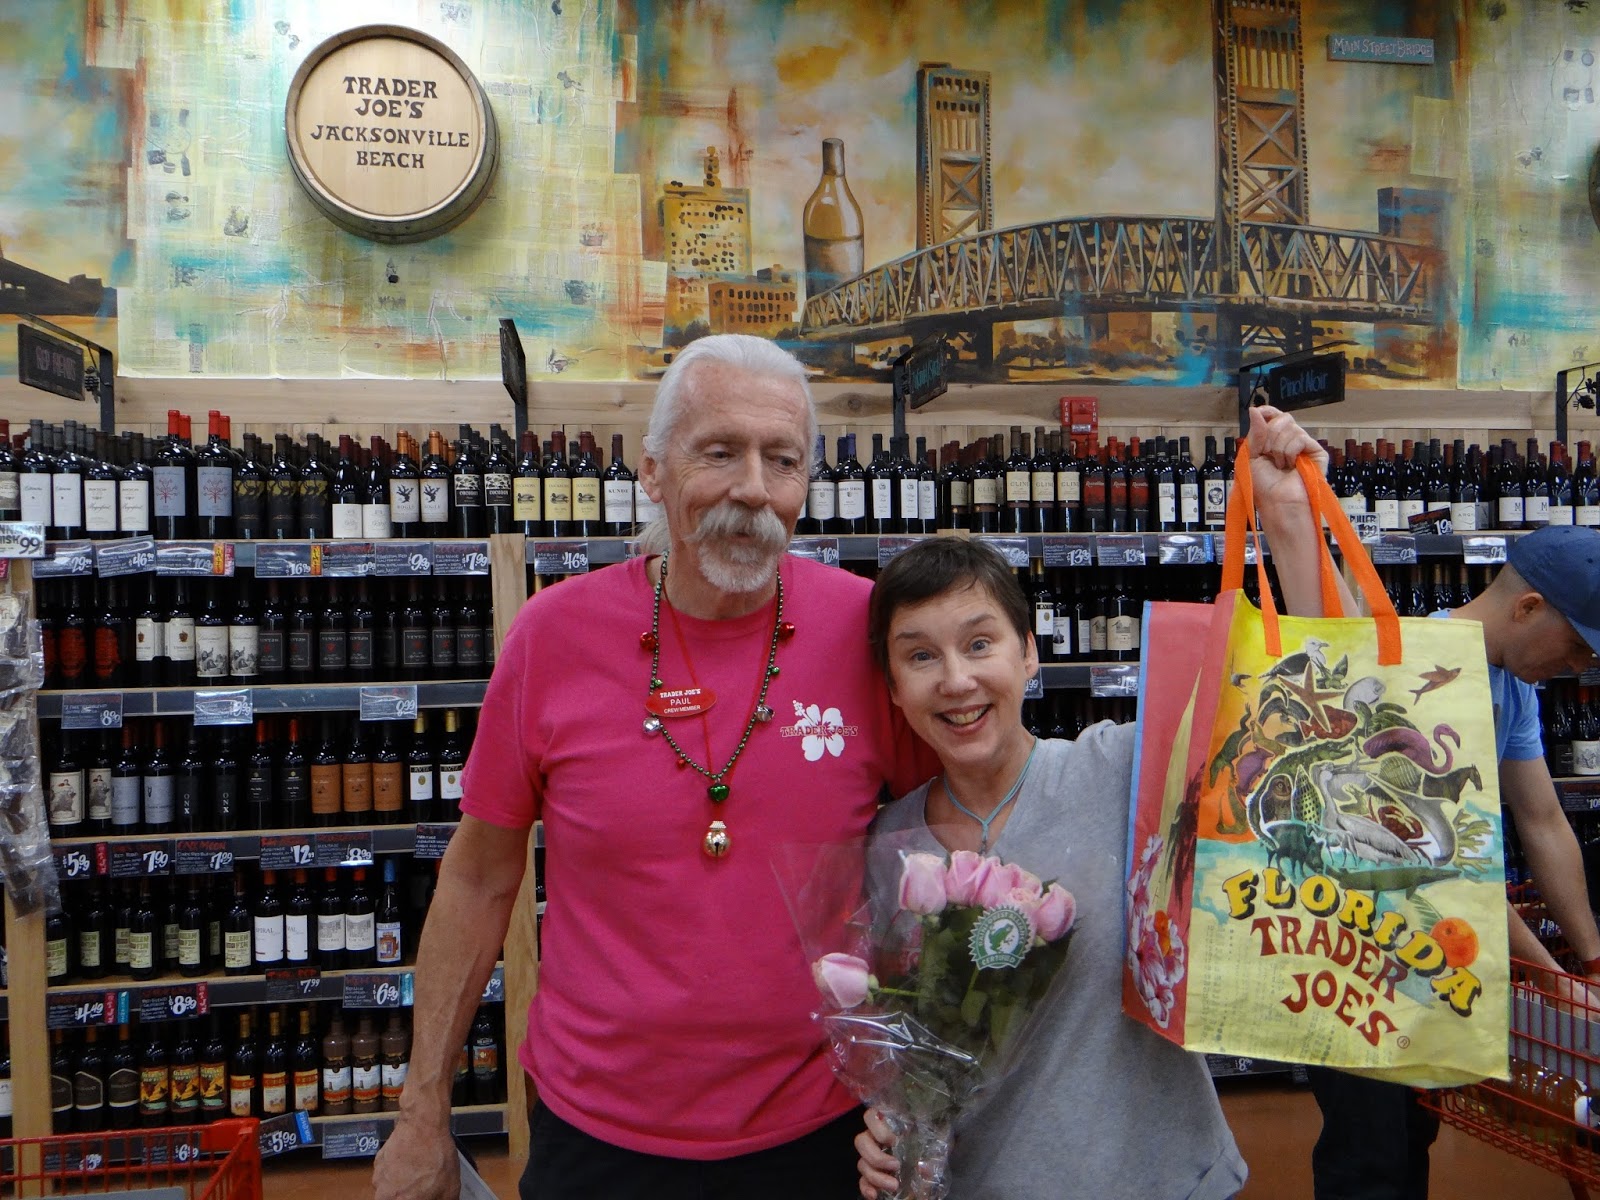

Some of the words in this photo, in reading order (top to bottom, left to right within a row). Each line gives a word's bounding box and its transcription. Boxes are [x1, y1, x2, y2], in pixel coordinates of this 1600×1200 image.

[1333, 39, 1360, 55] MAIN
[1361, 40, 1396, 55] STREET
[1397, 41, 1433, 57] BRIDGE
[343, 76, 438, 99] TRADER
[355, 98, 425, 119] JOE'S
[356, 151, 425, 169] BEACH
[1281, 369, 1305, 400] Pinot
[1305, 368, 1328, 393] Noir
[660, 689, 683, 699] TRADER
[684, 688, 702, 697] JOE'S
[670, 698, 692, 706] PAUL
[664, 706, 679, 714] CREW
[679, 704, 701, 712] MEMBER
[779, 725, 826, 738] TRADER
[830, 725, 859, 737] JOE'S
[1222, 867, 1482, 1018] FLORIDA
[1250, 915, 1408, 1003] TRADER
[1281, 969, 1399, 1047] JOE'S
